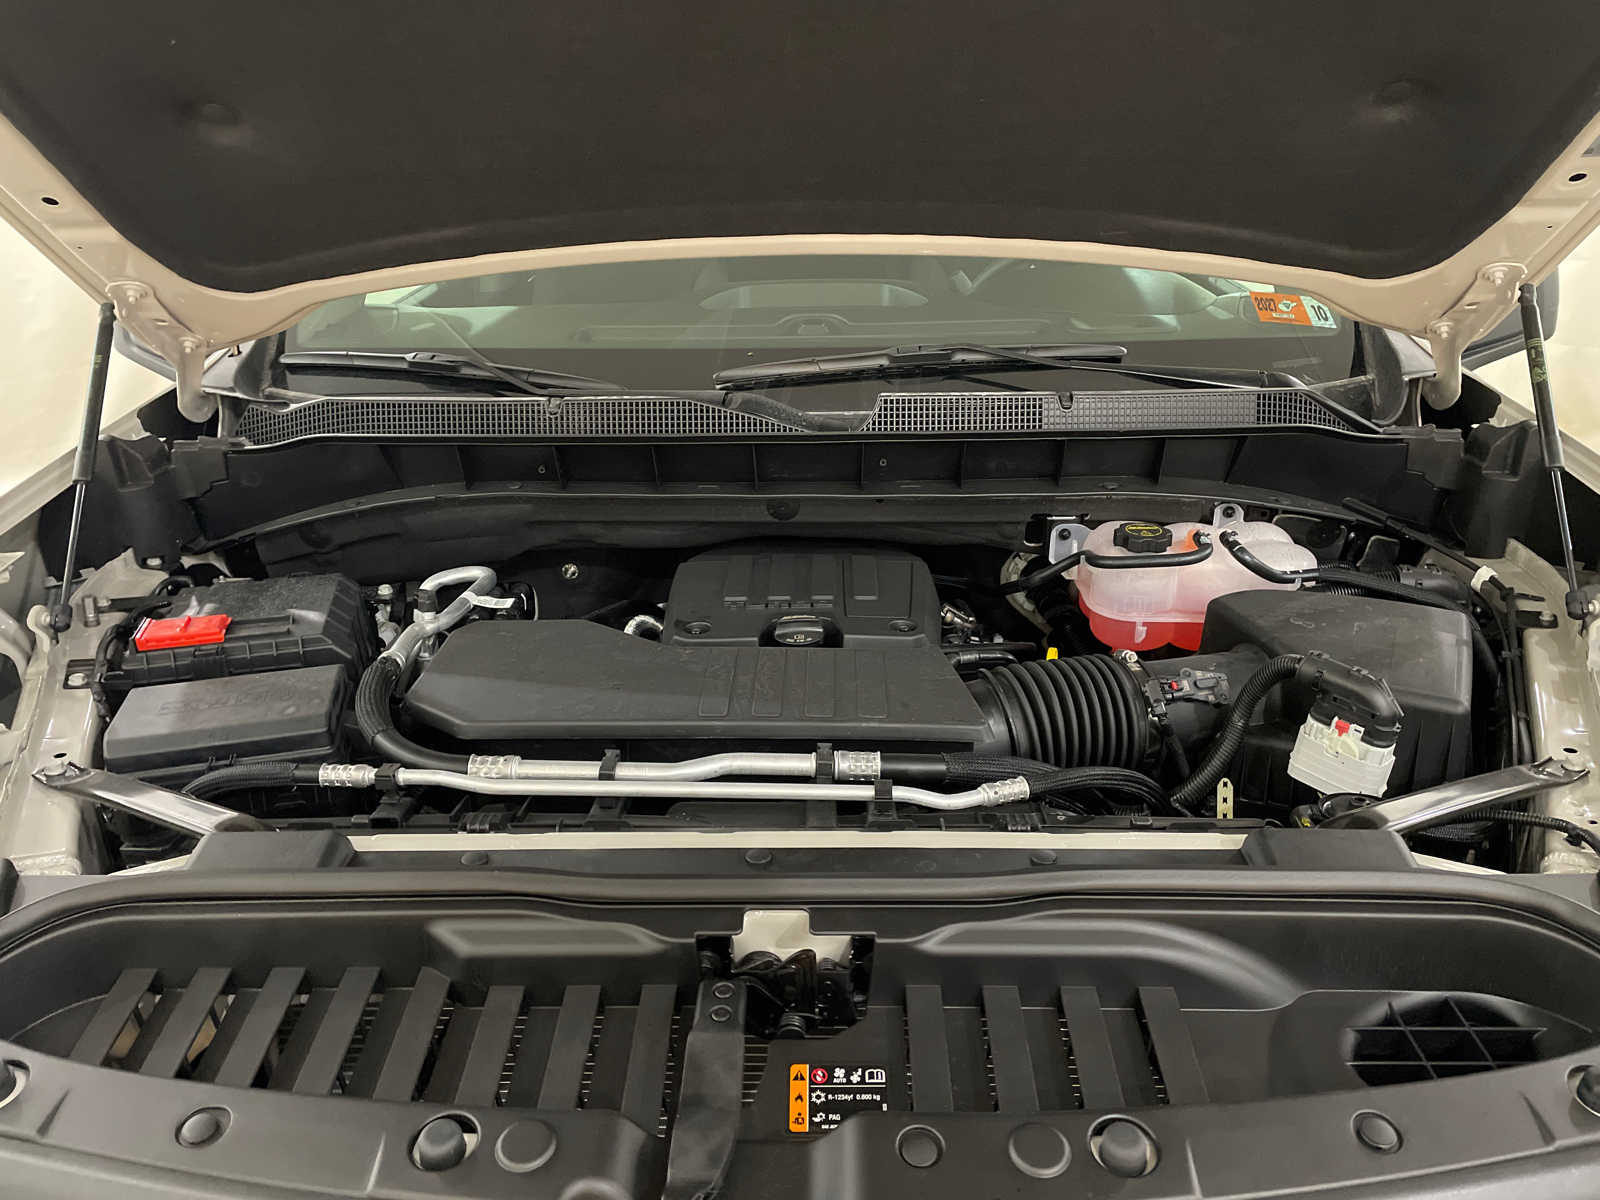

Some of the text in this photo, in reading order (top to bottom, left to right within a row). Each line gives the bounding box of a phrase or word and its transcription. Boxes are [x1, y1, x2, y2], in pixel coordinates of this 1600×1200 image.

[1254, 297, 1277, 312] 2027
[1310, 304, 1329, 321] 10
[828, 1093, 853, 1101] R-1234yf
[873, 1093, 880, 1101] kg
